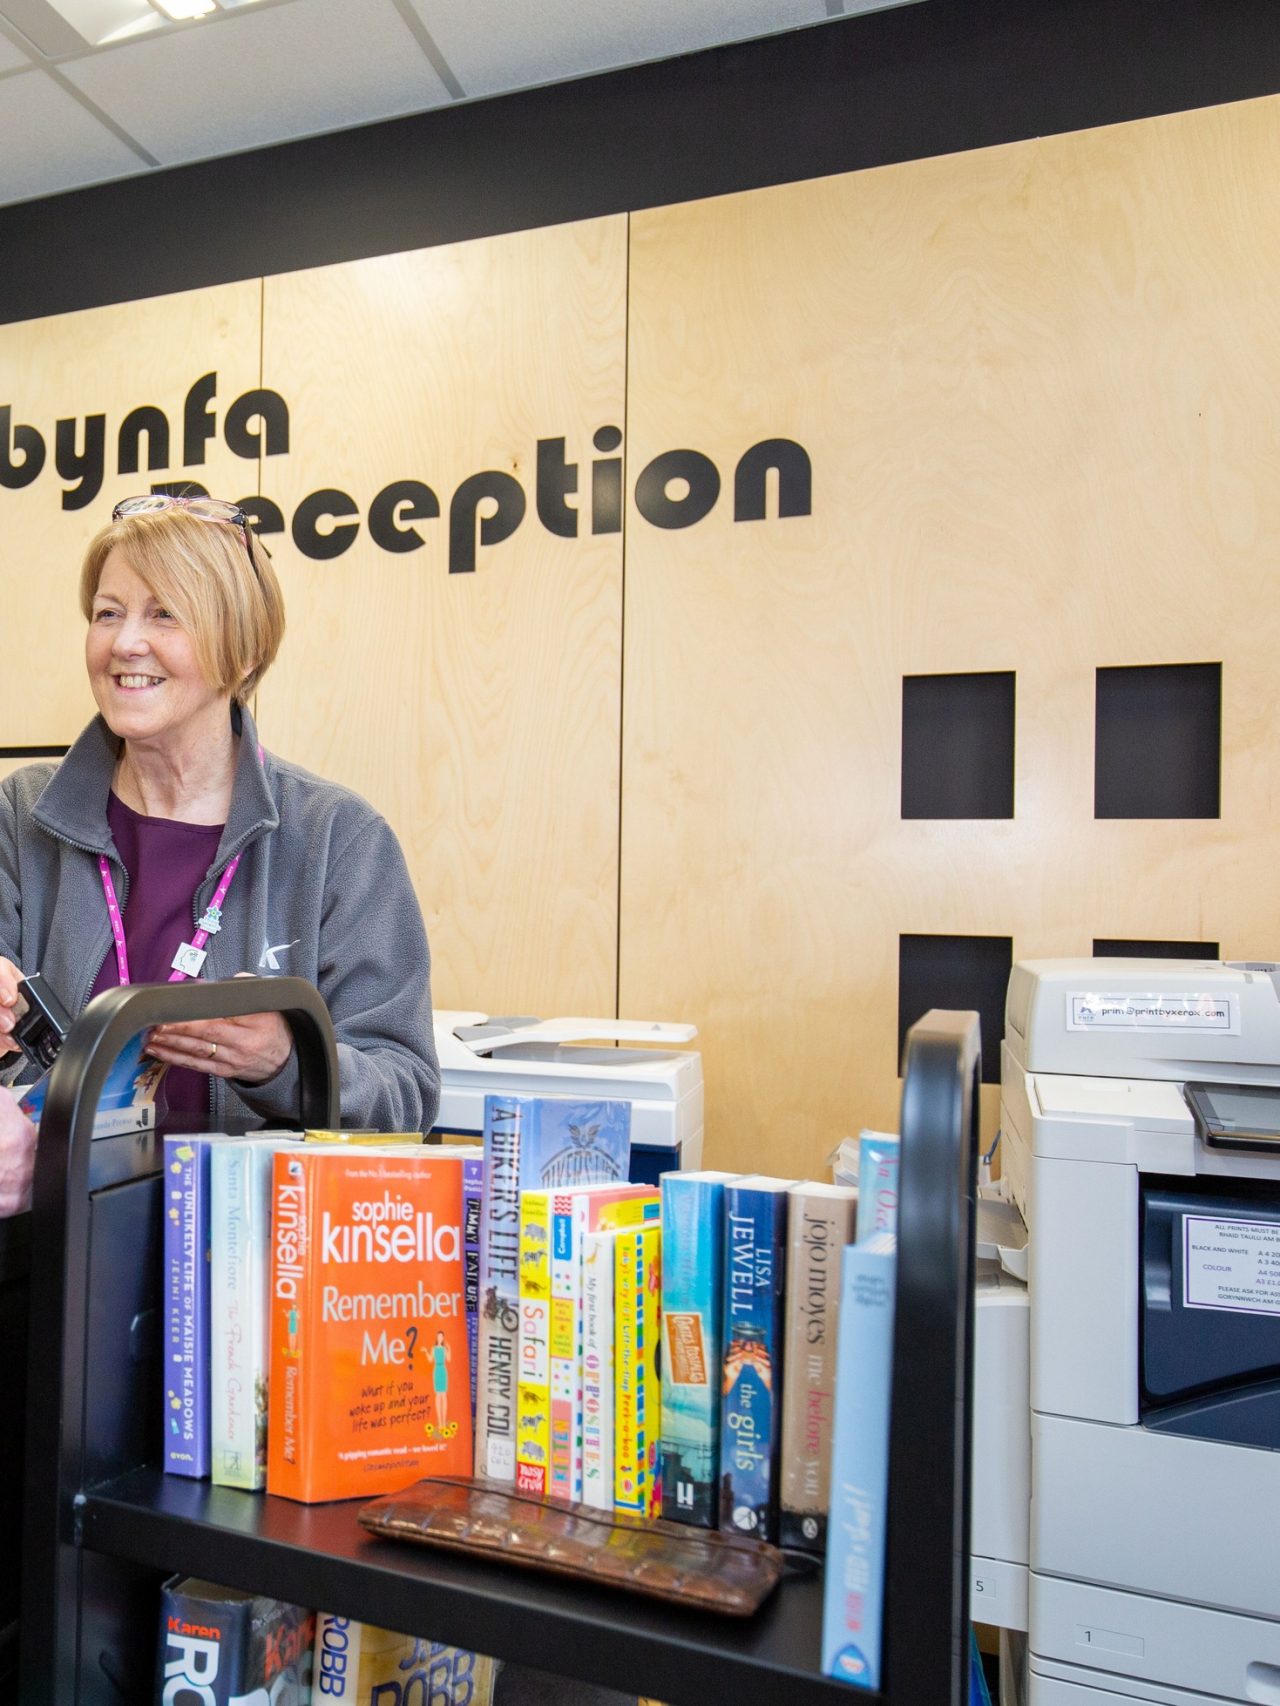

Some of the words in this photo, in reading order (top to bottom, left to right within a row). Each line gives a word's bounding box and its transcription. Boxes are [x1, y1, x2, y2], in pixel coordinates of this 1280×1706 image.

[151, 423, 812, 575] eception
[492, 1107, 523, 1122] A
[184, 1167, 193, 1186] THE
[489, 1131, 519, 1223] BIKER'S
[183, 1190, 195, 1258] UNLIKELY
[352, 1190, 414, 1230] sophie
[466, 1200, 481, 1243] TIMMY
[1227, 1225, 1249, 1233] PRINTS
[276, 1184, 305, 1300] kinsella
[322, 1211, 460, 1264] kinsella
[487, 1229, 518, 1281] LIFE
[804, 1213, 835, 1262] jojo
[171, 1258, 181, 1301] JENNI
[183, 1261, 195, 1291] LIFE
[465, 1251, 480, 1311] FAILURE
[587, 1277, 597, 1291] My
[729, 1213, 754, 1316] JEWELL
[755, 1247, 771, 1287] LISA
[1202, 1263, 1232, 1272] COLOUR
[184, 1296, 193, 1312] OF
[322, 1280, 461, 1323] Remember
[587, 1293, 598, 1312] first
[620, 1277, 631, 1299] very
[800, 1269, 827, 1344] moyes
[1218, 1285, 1239, 1293] PLEASE
[171, 1308, 181, 1343] KEER
[183, 1315, 195, 1363] MAISIE
[523, 1305, 545, 1377] Safari
[587, 1336, 597, 1349] of
[588, 1313, 598, 1334] book
[361, 1326, 418, 1371] Me?
[488, 1335, 512, 1400] HENRY
[397, 1381, 414, 1395] you
[807, 1355, 823, 1385] me
[183, 1367, 194, 1440] MEADOWS
[283, 1366, 297, 1434] Remember
[349, 1402, 371, 1417] woke
[373, 1403, 385, 1414] up
[388, 1395, 406, 1410] and
[408, 1394, 431, 1407] your
[739, 1383, 753, 1408] the
[352, 1417, 368, 1432] life
[370, 1418, 387, 1428] was
[389, 1406, 431, 1425] perfect?
[487, 1403, 510, 1442] COL
[585, 1354, 600, 1480] OPPOSITES
[621, 1394, 631, 1459] Peek-a-boo
[806, 1389, 832, 1455] before
[727, 1413, 764, 1472] girls
[804, 1460, 819, 1496] you
[975, 1580, 984, 1592] 5
[167, 1616, 220, 1640] Karen
[1084, 1631, 1091, 1642] 1
[320, 1614, 351, 1697] ROBB
